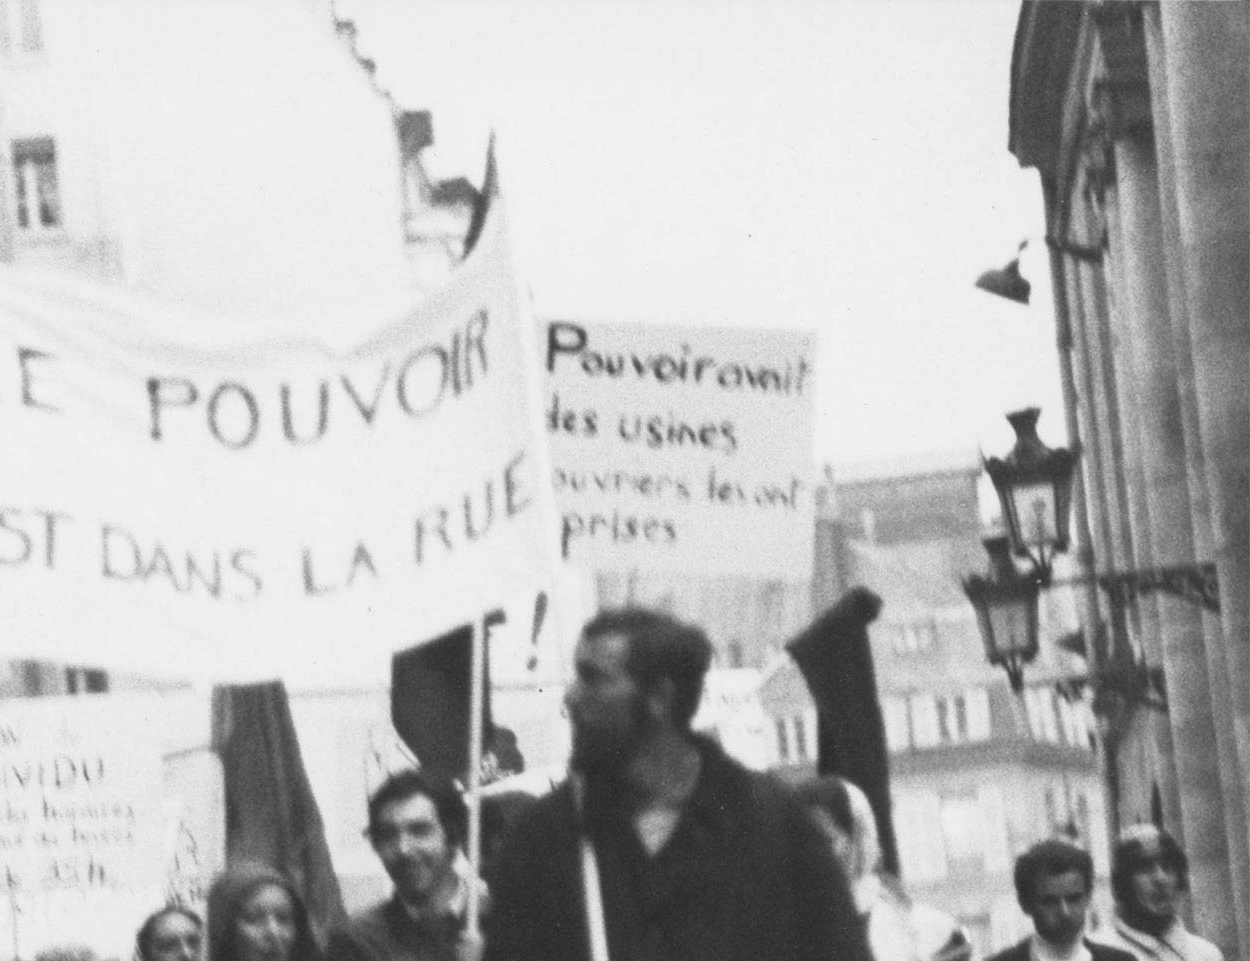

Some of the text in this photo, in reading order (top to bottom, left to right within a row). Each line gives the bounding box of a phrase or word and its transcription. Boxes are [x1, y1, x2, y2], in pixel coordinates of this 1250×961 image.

[147, 308, 490, 450] POUVOIR
[546, 320, 716, 385] Pouvoir
[617, 411, 739, 456] usines
[101, 523, 266, 600] DANS
[303, 541, 378, 596] LA
[413, 449, 534, 565] RUE
[560, 507, 678, 562] prises
